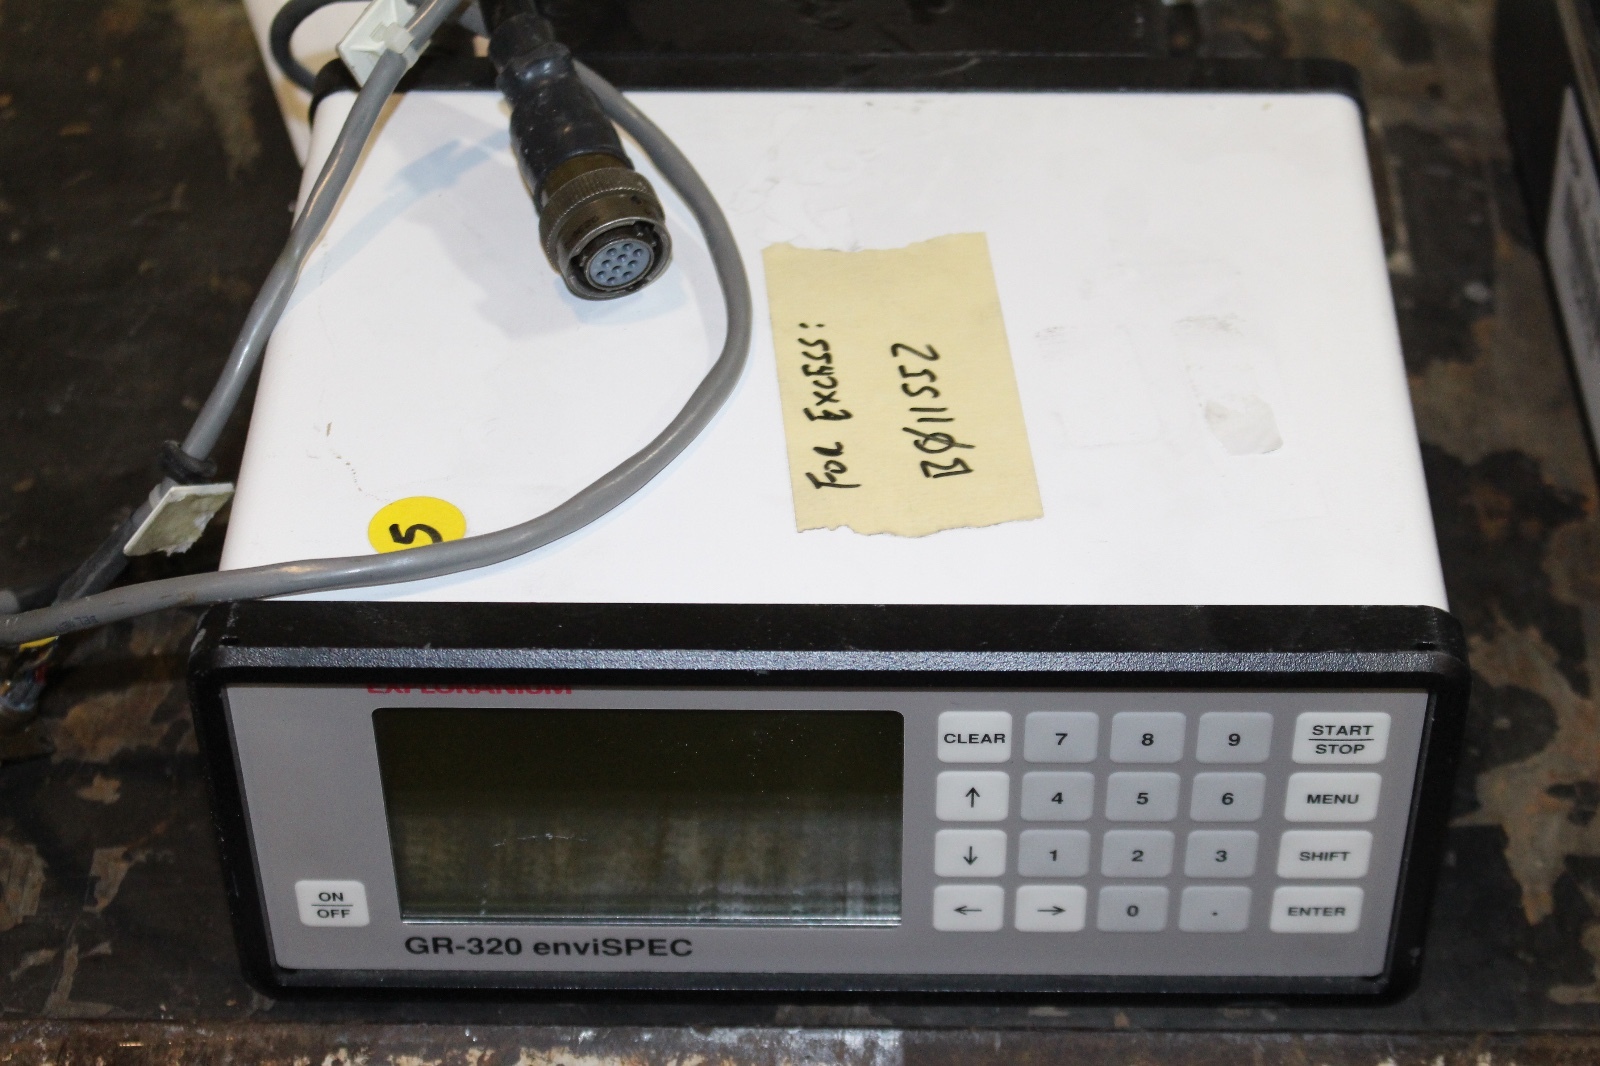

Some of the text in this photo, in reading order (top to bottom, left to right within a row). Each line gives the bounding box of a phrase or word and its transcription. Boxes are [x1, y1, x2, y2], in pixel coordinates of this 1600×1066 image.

[1311, 724, 1374, 736] START
[943, 733, 1006, 744] CLEAR
[1055, 732, 1069, 746] 7
[1141, 732, 1155, 747] 8
[1228, 733, 1241, 747] 9
[1315, 743, 1365, 755] STOP
[1051, 792, 1064, 805] 4
[1136, 792, 1149, 806] 5
[1221, 792, 1234, 806] 6
[1306, 793, 1360, 805] MENU
[1049, 849, 1058, 862] 1
[1131, 849, 1144, 863] 2
[1215, 849, 1228, 863] 3
[1299, 851, 1351, 862] SHIFT
[318, 892, 344, 902] ON
[316, 908, 350, 919] OFF
[1126, 904, 1140, 918] 0
[1287, 906, 1346, 917] ENTER
[404, 936, 693, 958] GR-320 enviSPEC
